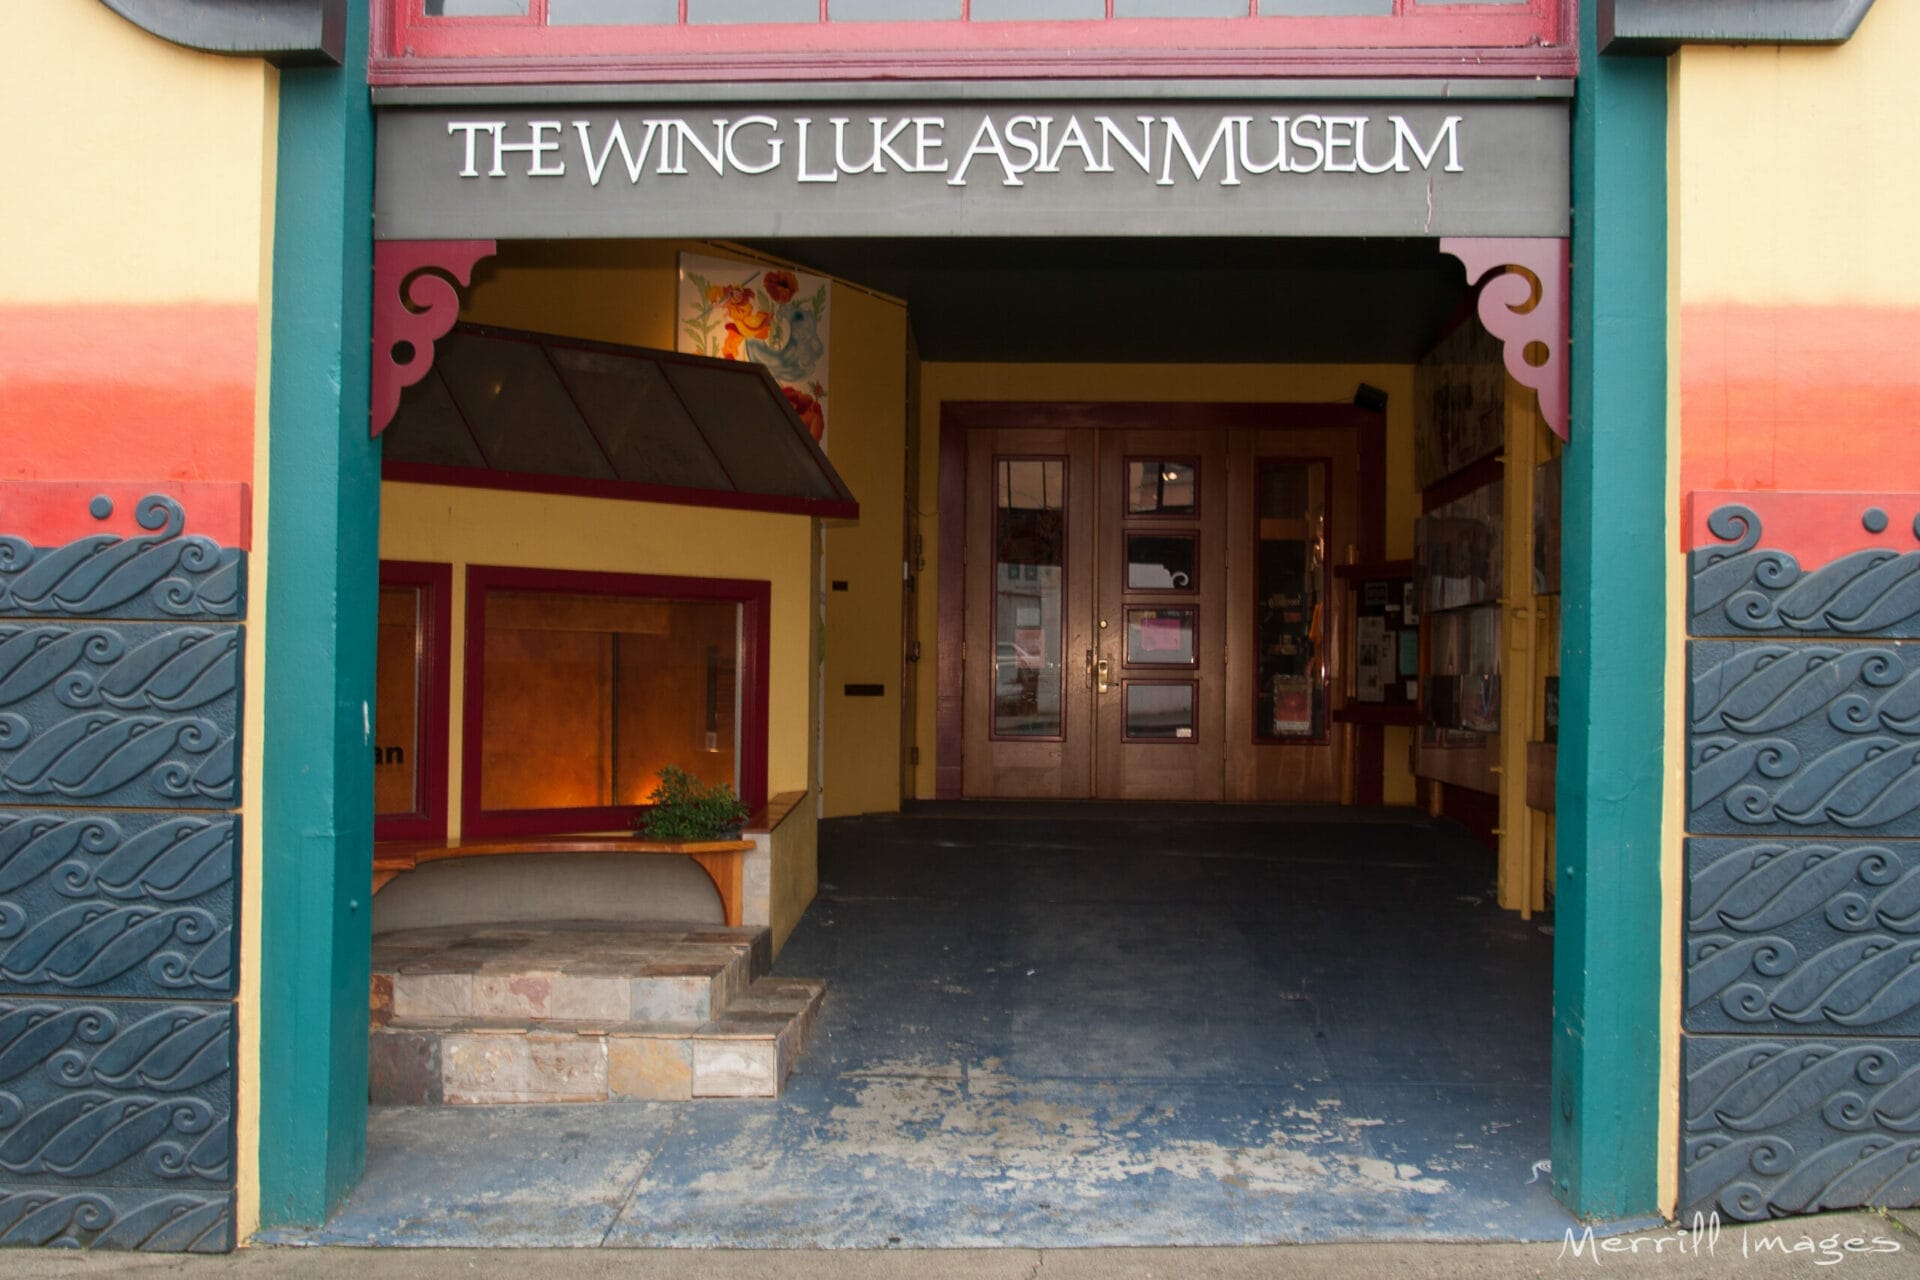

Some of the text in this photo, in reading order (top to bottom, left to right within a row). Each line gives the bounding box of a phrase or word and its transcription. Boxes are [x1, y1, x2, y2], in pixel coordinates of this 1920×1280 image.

[447, 114, 1464, 187] THE WING LUKE ASIAN MUSEUM
